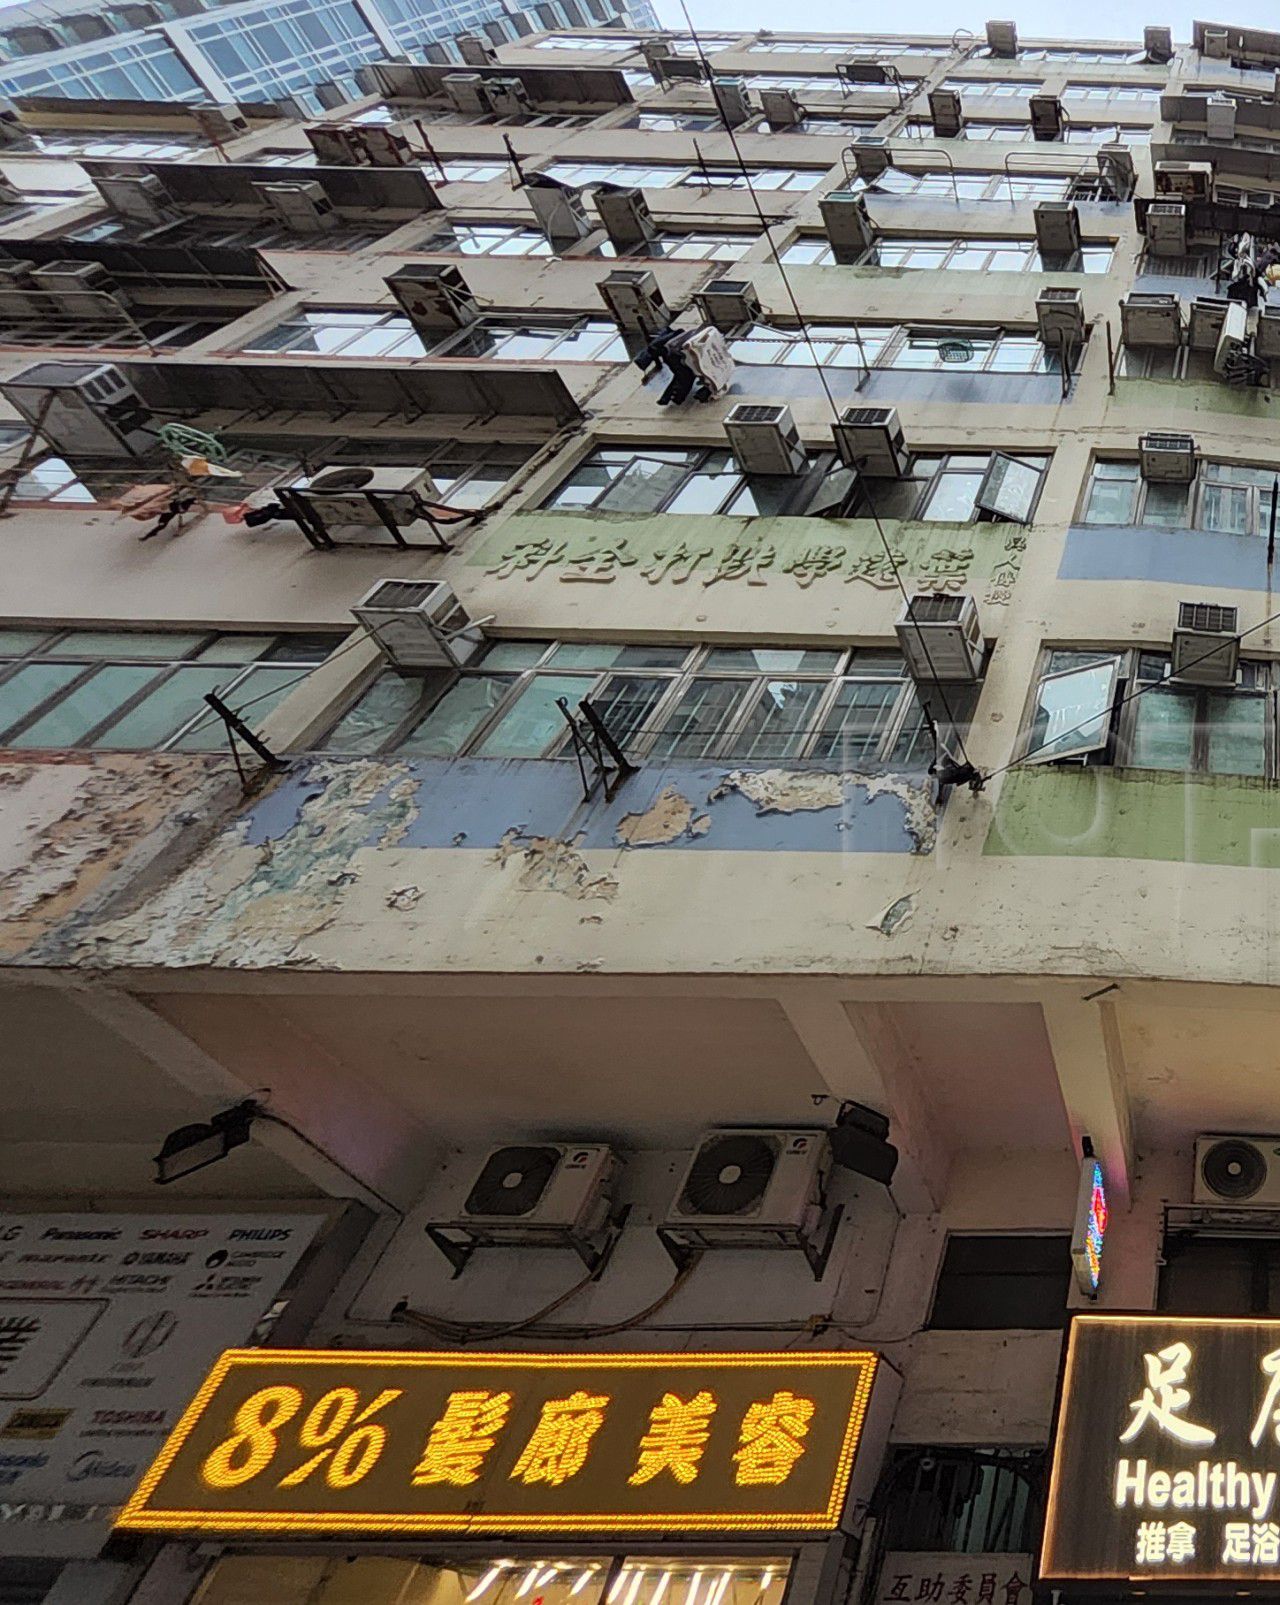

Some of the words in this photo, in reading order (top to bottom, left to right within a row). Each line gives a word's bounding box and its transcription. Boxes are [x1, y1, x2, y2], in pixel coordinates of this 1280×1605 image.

[139, 1228, 210, 1241] SHARP
[227, 1228, 294, 1241] PHILIPS
[92, 1409, 168, 1425] TOSHIBA
[202, 1385, 406, 1489] 8%
[1115, 1459, 1275, 1518] Healthy
[1136, 1521, 1197, 1564] 推拿
